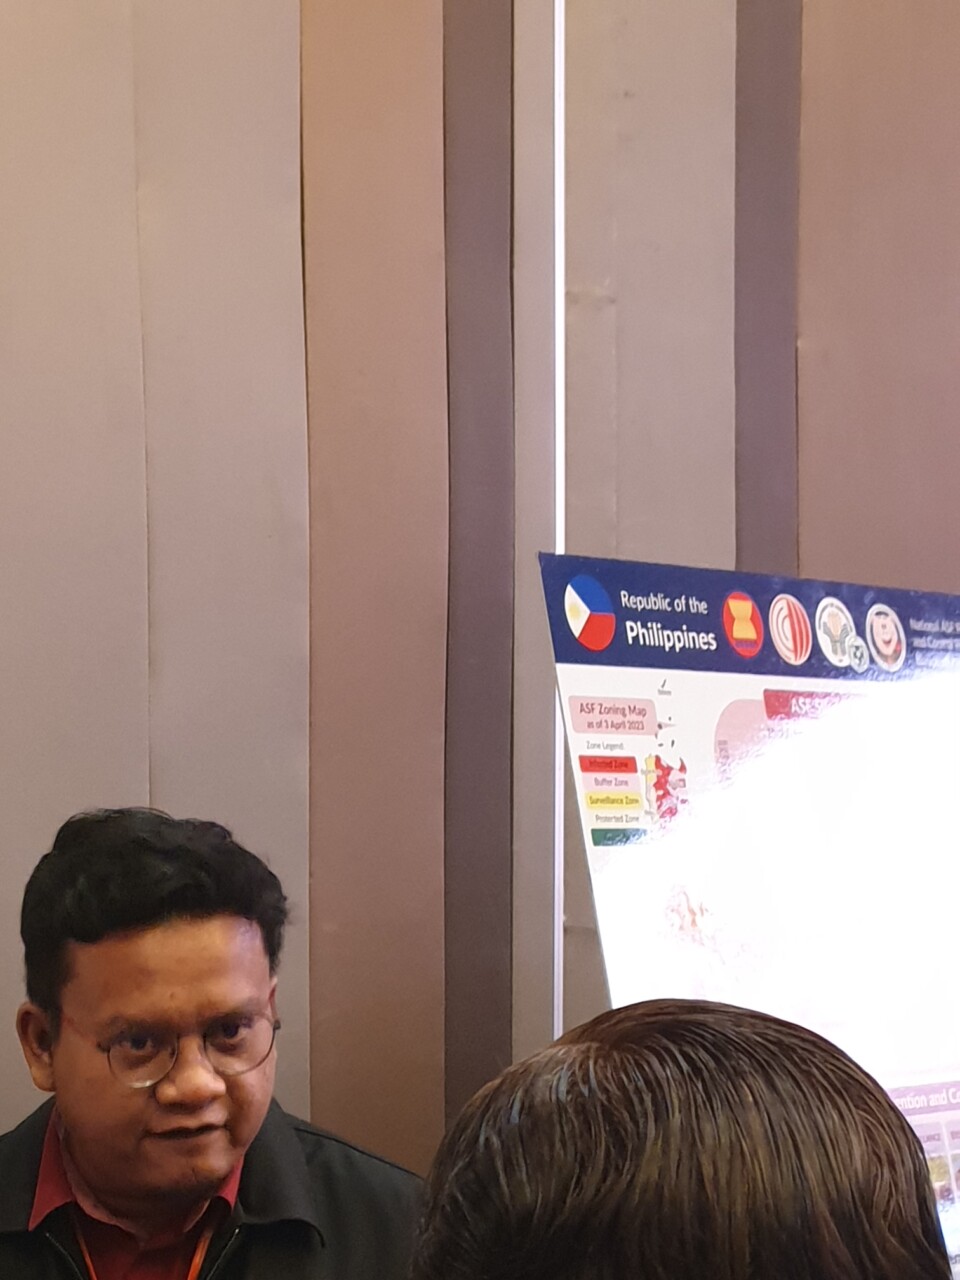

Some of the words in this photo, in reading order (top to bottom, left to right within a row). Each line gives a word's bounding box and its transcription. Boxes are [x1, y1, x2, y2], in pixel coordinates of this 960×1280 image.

[621, 590, 673, 612] Republic
[675, 596, 687, 613] of
[689, 598, 708, 615] the
[625, 621, 717, 652] Philippines
[580, 703, 595, 714] ASF
[599, 704, 627, 717] Zoning
[628, 706, 646, 718] Map
[611, 721, 626, 730] April
